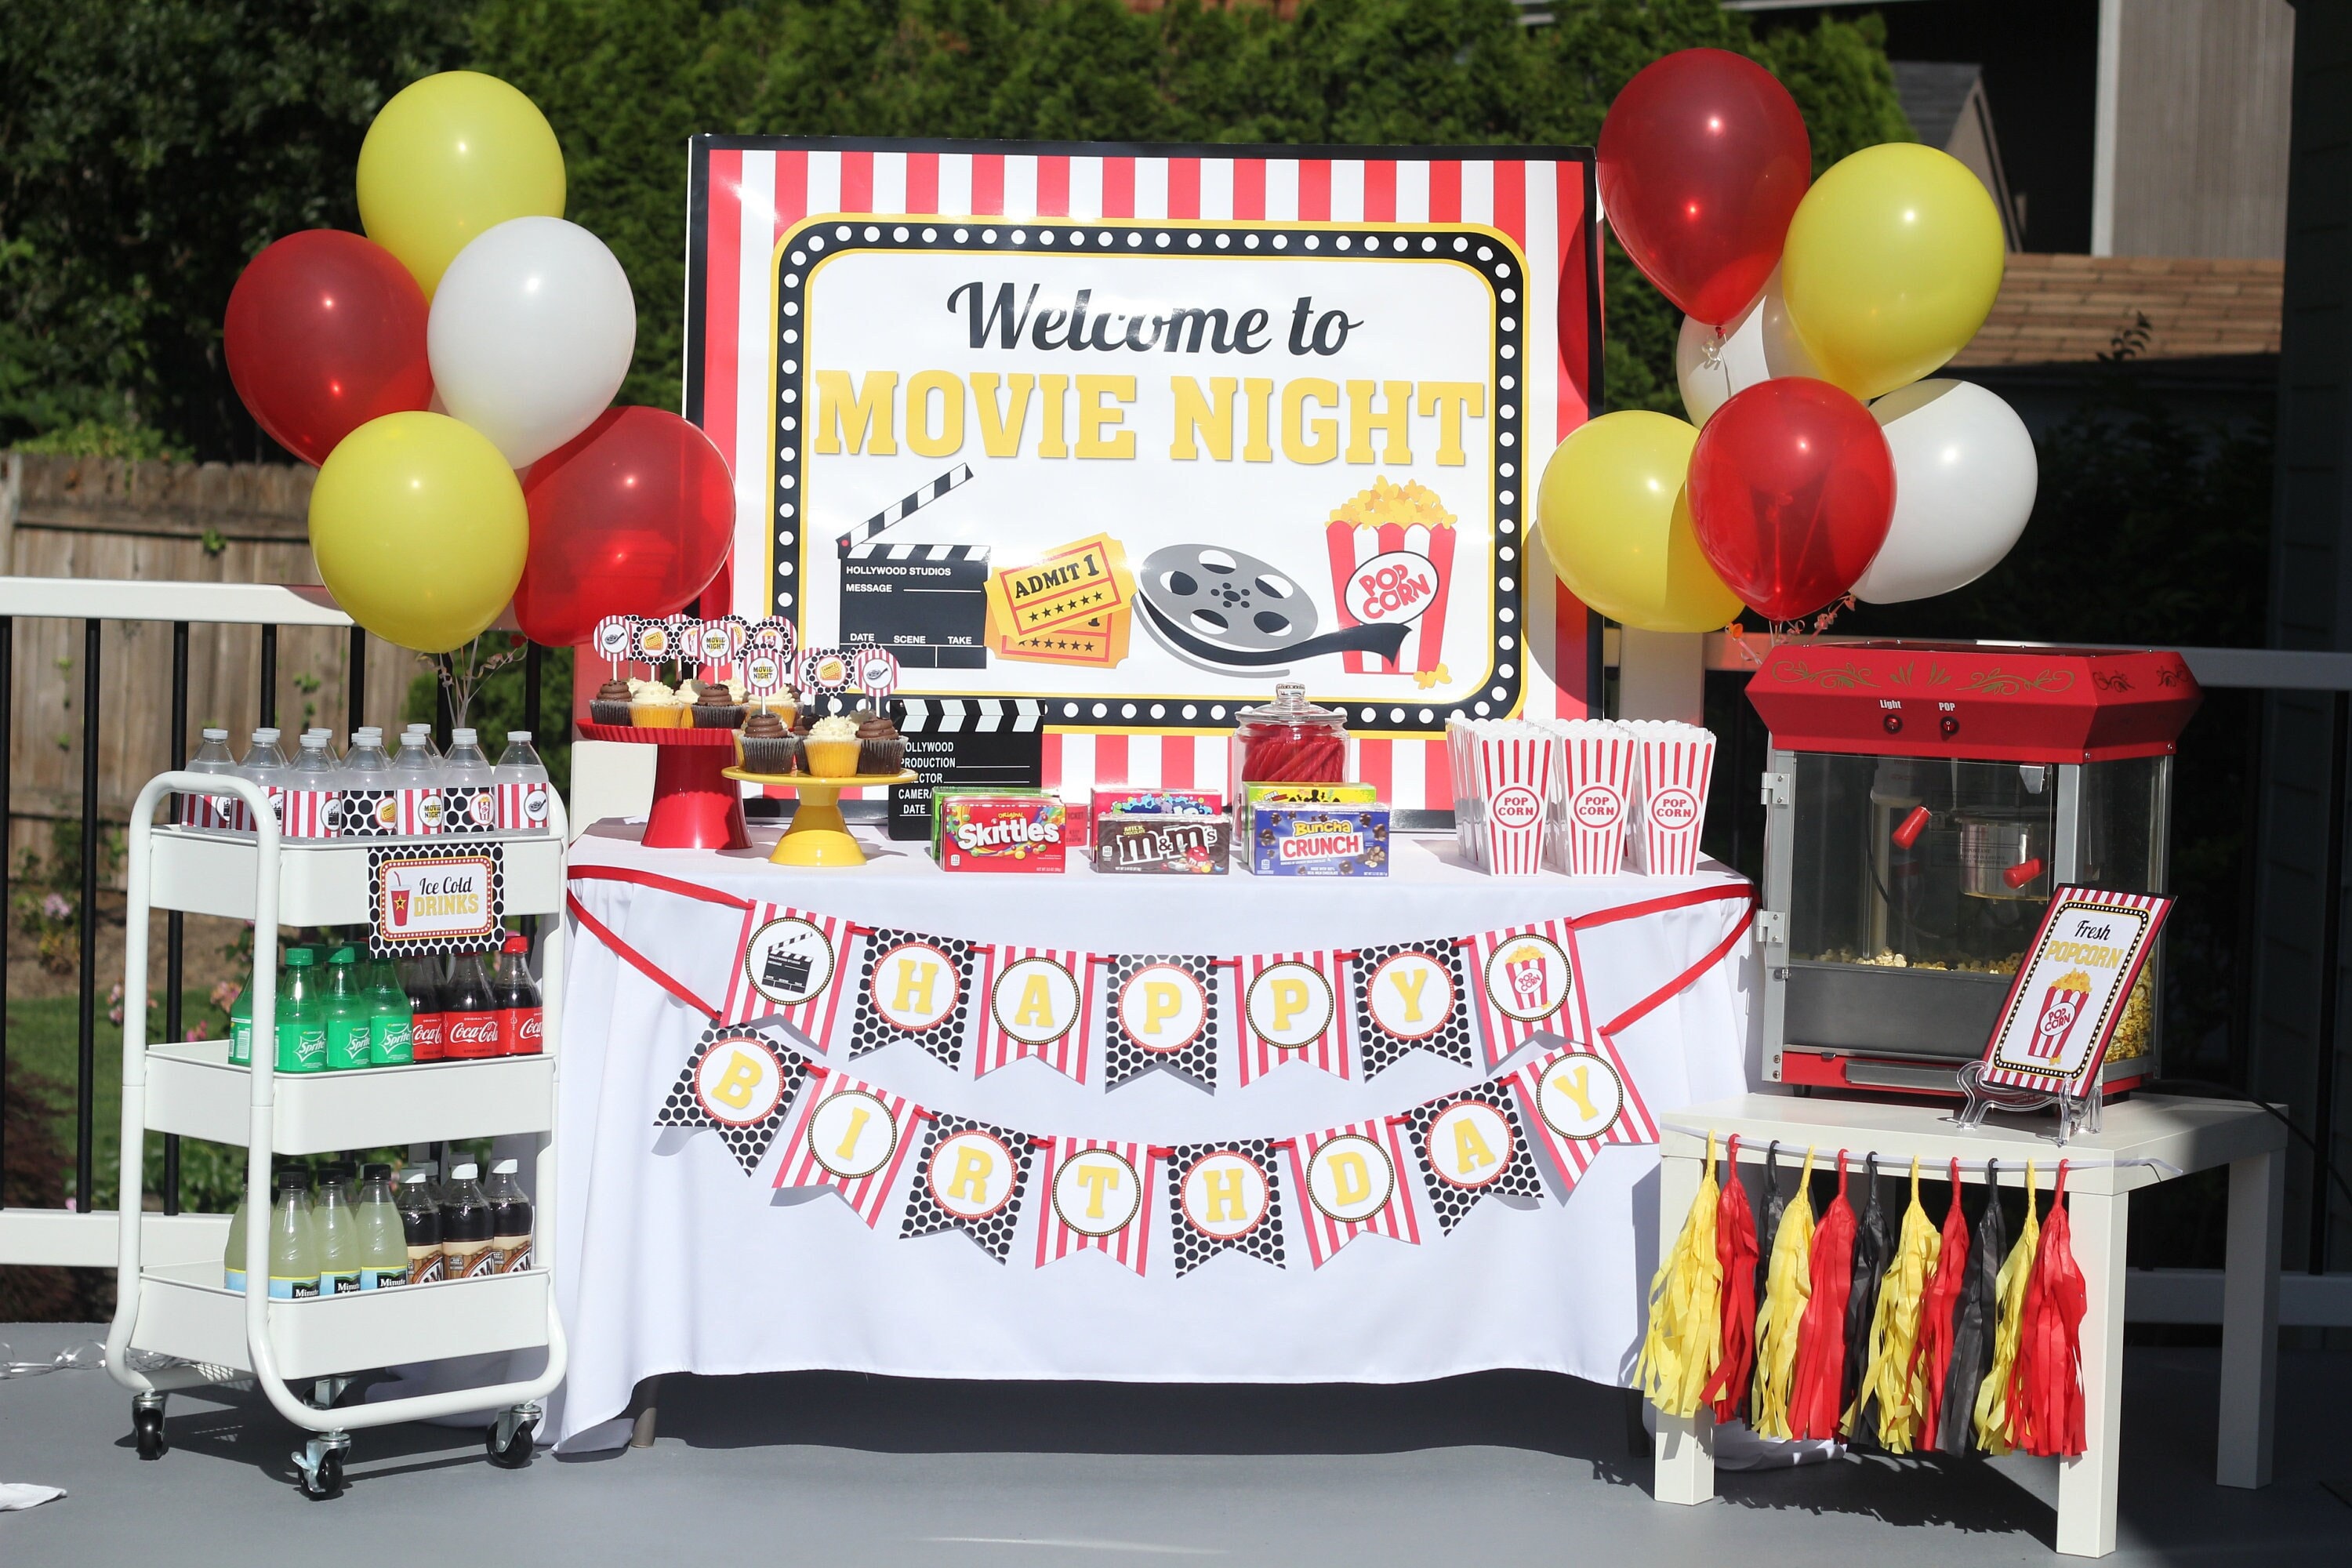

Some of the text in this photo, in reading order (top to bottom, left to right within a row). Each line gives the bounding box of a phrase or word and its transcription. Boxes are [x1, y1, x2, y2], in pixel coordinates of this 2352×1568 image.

[946, 281, 1365, 357] Welcome to
[813, 369, 1485, 466] MOVIE NIGHT
[846, 566, 952, 576] HOLLYWOOD STUDIOS
[1015, 562, 1080, 599] ADMIT
[1359, 564, 1408, 597] POP
[846, 583, 892, 593] MESSAGE
[1363, 573, 1432, 619] CORN
[850, 633, 972, 644] DATE SCENE TAKE
[1879, 699, 1955, 711] Light POP
[905, 742, 954, 753] OLLYWOOD
[1264, 790, 1279, 800] SOUR
[1504, 797, 1528, 806] POP
[1585, 797, 1610, 806] POP
[903, 804, 926, 814] DATE
[1662, 798, 1687, 808] POP
[1497, 807, 1534, 816] CORN
[1579, 806, 1615, 816] CORN
[1656, 808, 1692, 818] CORN
[957, 818, 1060, 850] Skittles
[1294, 821, 1352, 837] Buncha
[1283, 835, 1359, 858] CRUNCH
[419, 876, 473, 895] Ice Cold
[413, 894, 479, 917] DRINKS
[2074, 920, 2111, 941] Fresh
[2043, 940, 2125, 969] POPCORN
[1518, 972, 1533, 985] POP
[1521, 974, 1541, 992] CORN
[2048, 1007, 2067, 1022] POP
[2044, 1013, 2071, 1033] CORN
[384, 1032, 411, 1046] Sprite
[299, 1040, 325, 1054] Sprite
[337, 1283, 360, 1291] Minute
[380, 1278, 406, 1287] Minute
[295, 1288, 319, 1298] Minute
